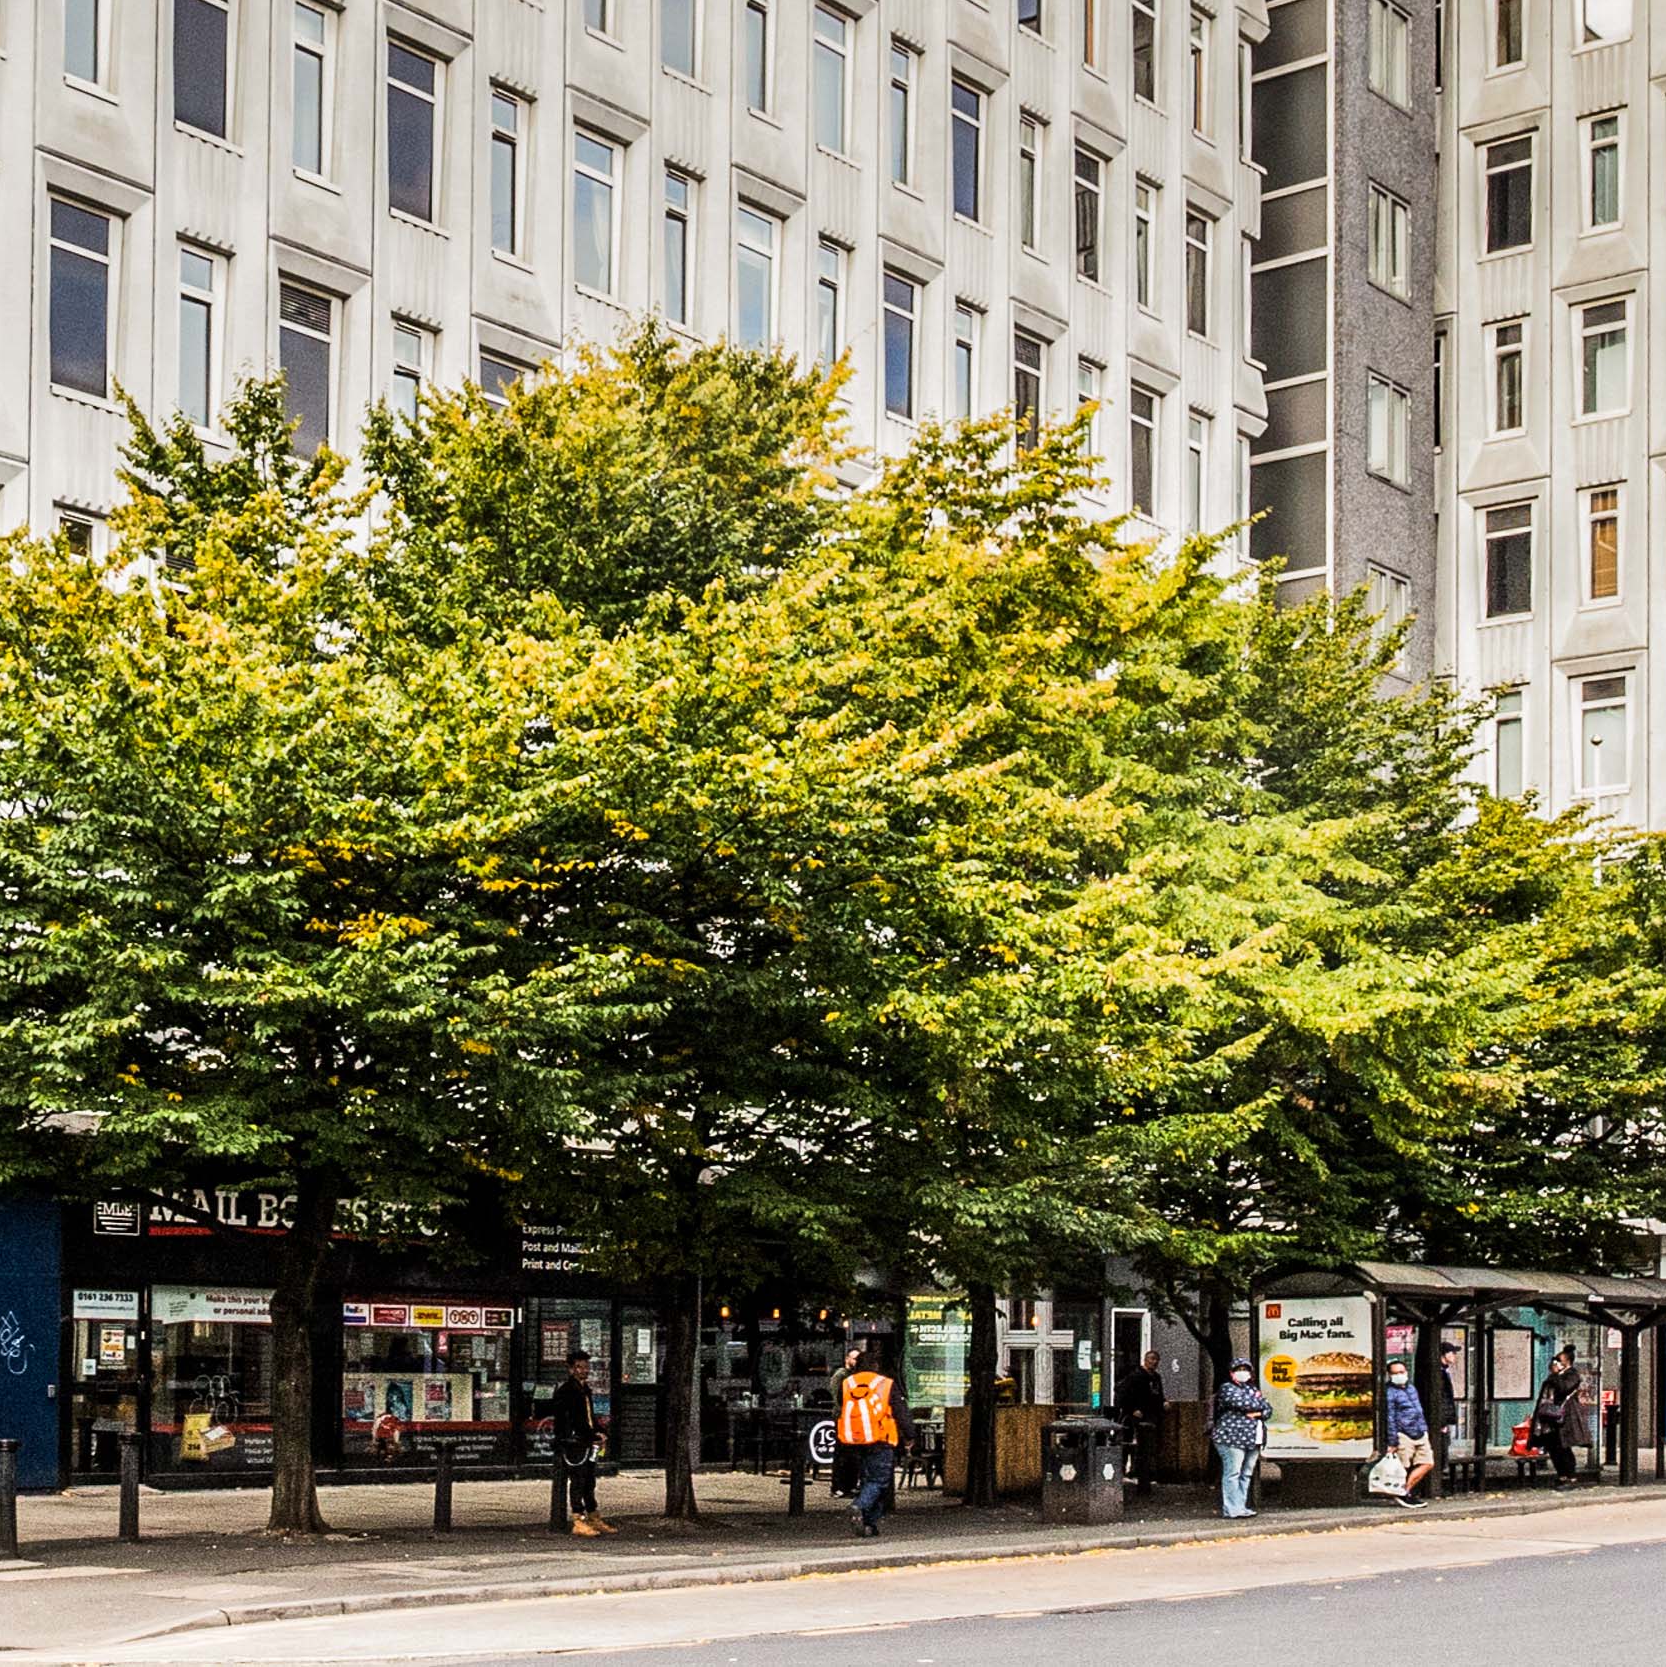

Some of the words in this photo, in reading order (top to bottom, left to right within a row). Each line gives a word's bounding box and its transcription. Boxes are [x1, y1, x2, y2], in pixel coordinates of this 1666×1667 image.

[522, 1241, 541, 1252] Post
[543, 1242, 559, 1252] and
[522, 1258, 543, 1269] Print
[545, 1259, 561, 1270] and
[78, 1293, 97, 1302] 0161
[206, 1294, 226, 1303] Make
[228, 1295, 241, 1304] this
[243, 1296, 260, 1305] your
[222, 1307, 256, 1316] personal
[1288, 1317, 1327, 1329] Calling
[1329, 1317, 1343, 1326] all
[1279, 1330, 1298, 1342] Big
[1300, 1330, 1323, 1339] Mac
[1327, 1329, 1355, 1339] fans.
[1272, 1366, 1288, 1376] Big
[1272, 1375, 1292, 1383] Mac
